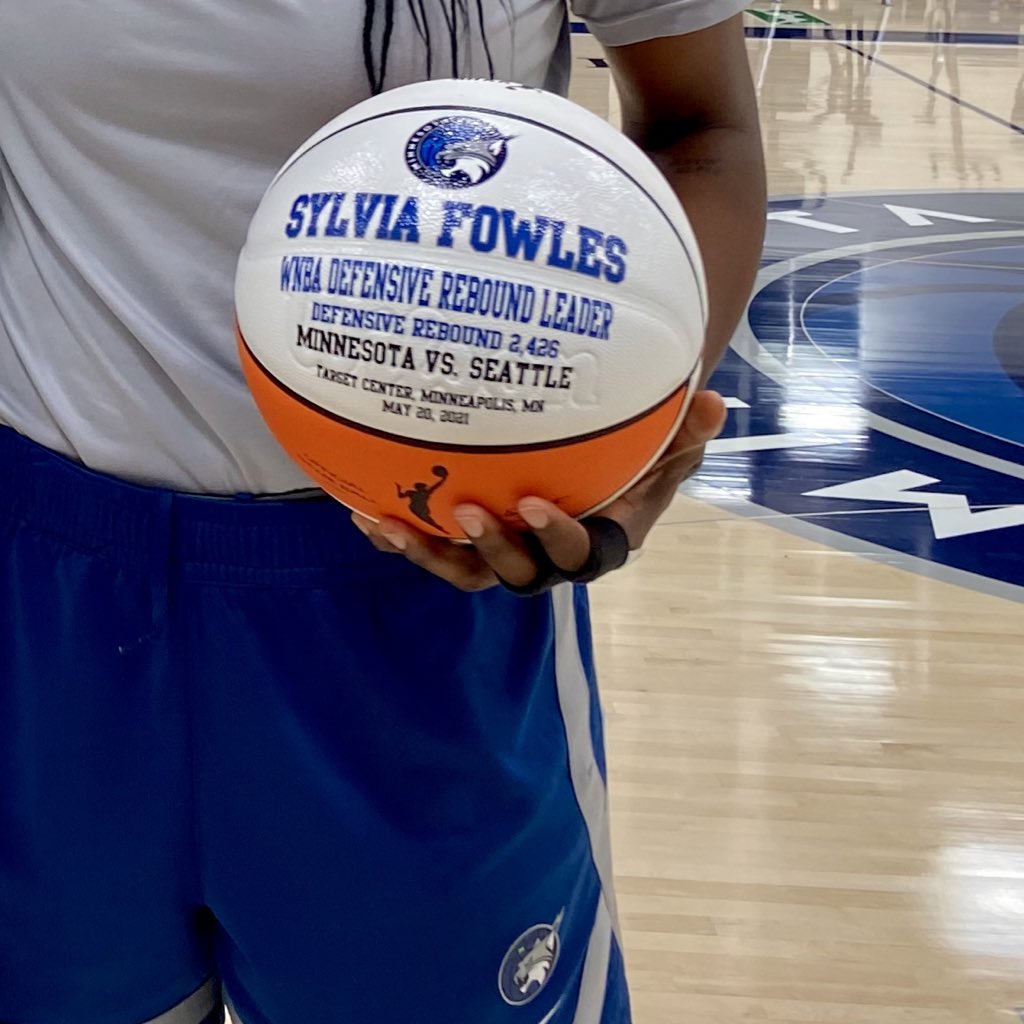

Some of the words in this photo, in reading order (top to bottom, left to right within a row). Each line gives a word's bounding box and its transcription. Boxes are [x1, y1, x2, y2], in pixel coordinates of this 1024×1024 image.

[285, 191, 420, 244] SYLVIA
[436, 200, 629, 284] FOWLES
[280, 255, 322, 294] WNBA
[327, 258, 432, 307] DEFENSIVE
[438, 272, 537, 324] REBOUND
[542, 288, 615, 341] LEADER
[296, 325, 415, 371] MINNESOTA
[425, 349, 458, 377] VS.
[469, 356, 573, 390] SEATTLE
[311, 301, 406, 335] DEFENSIVE
[412, 317, 503, 350] REBOUND
[509, 334, 560, 359] 2,426
[316, 364, 358, 387] TARGET
[522, 399, 544, 413] MN
[382, 400, 410, 416] MAY
